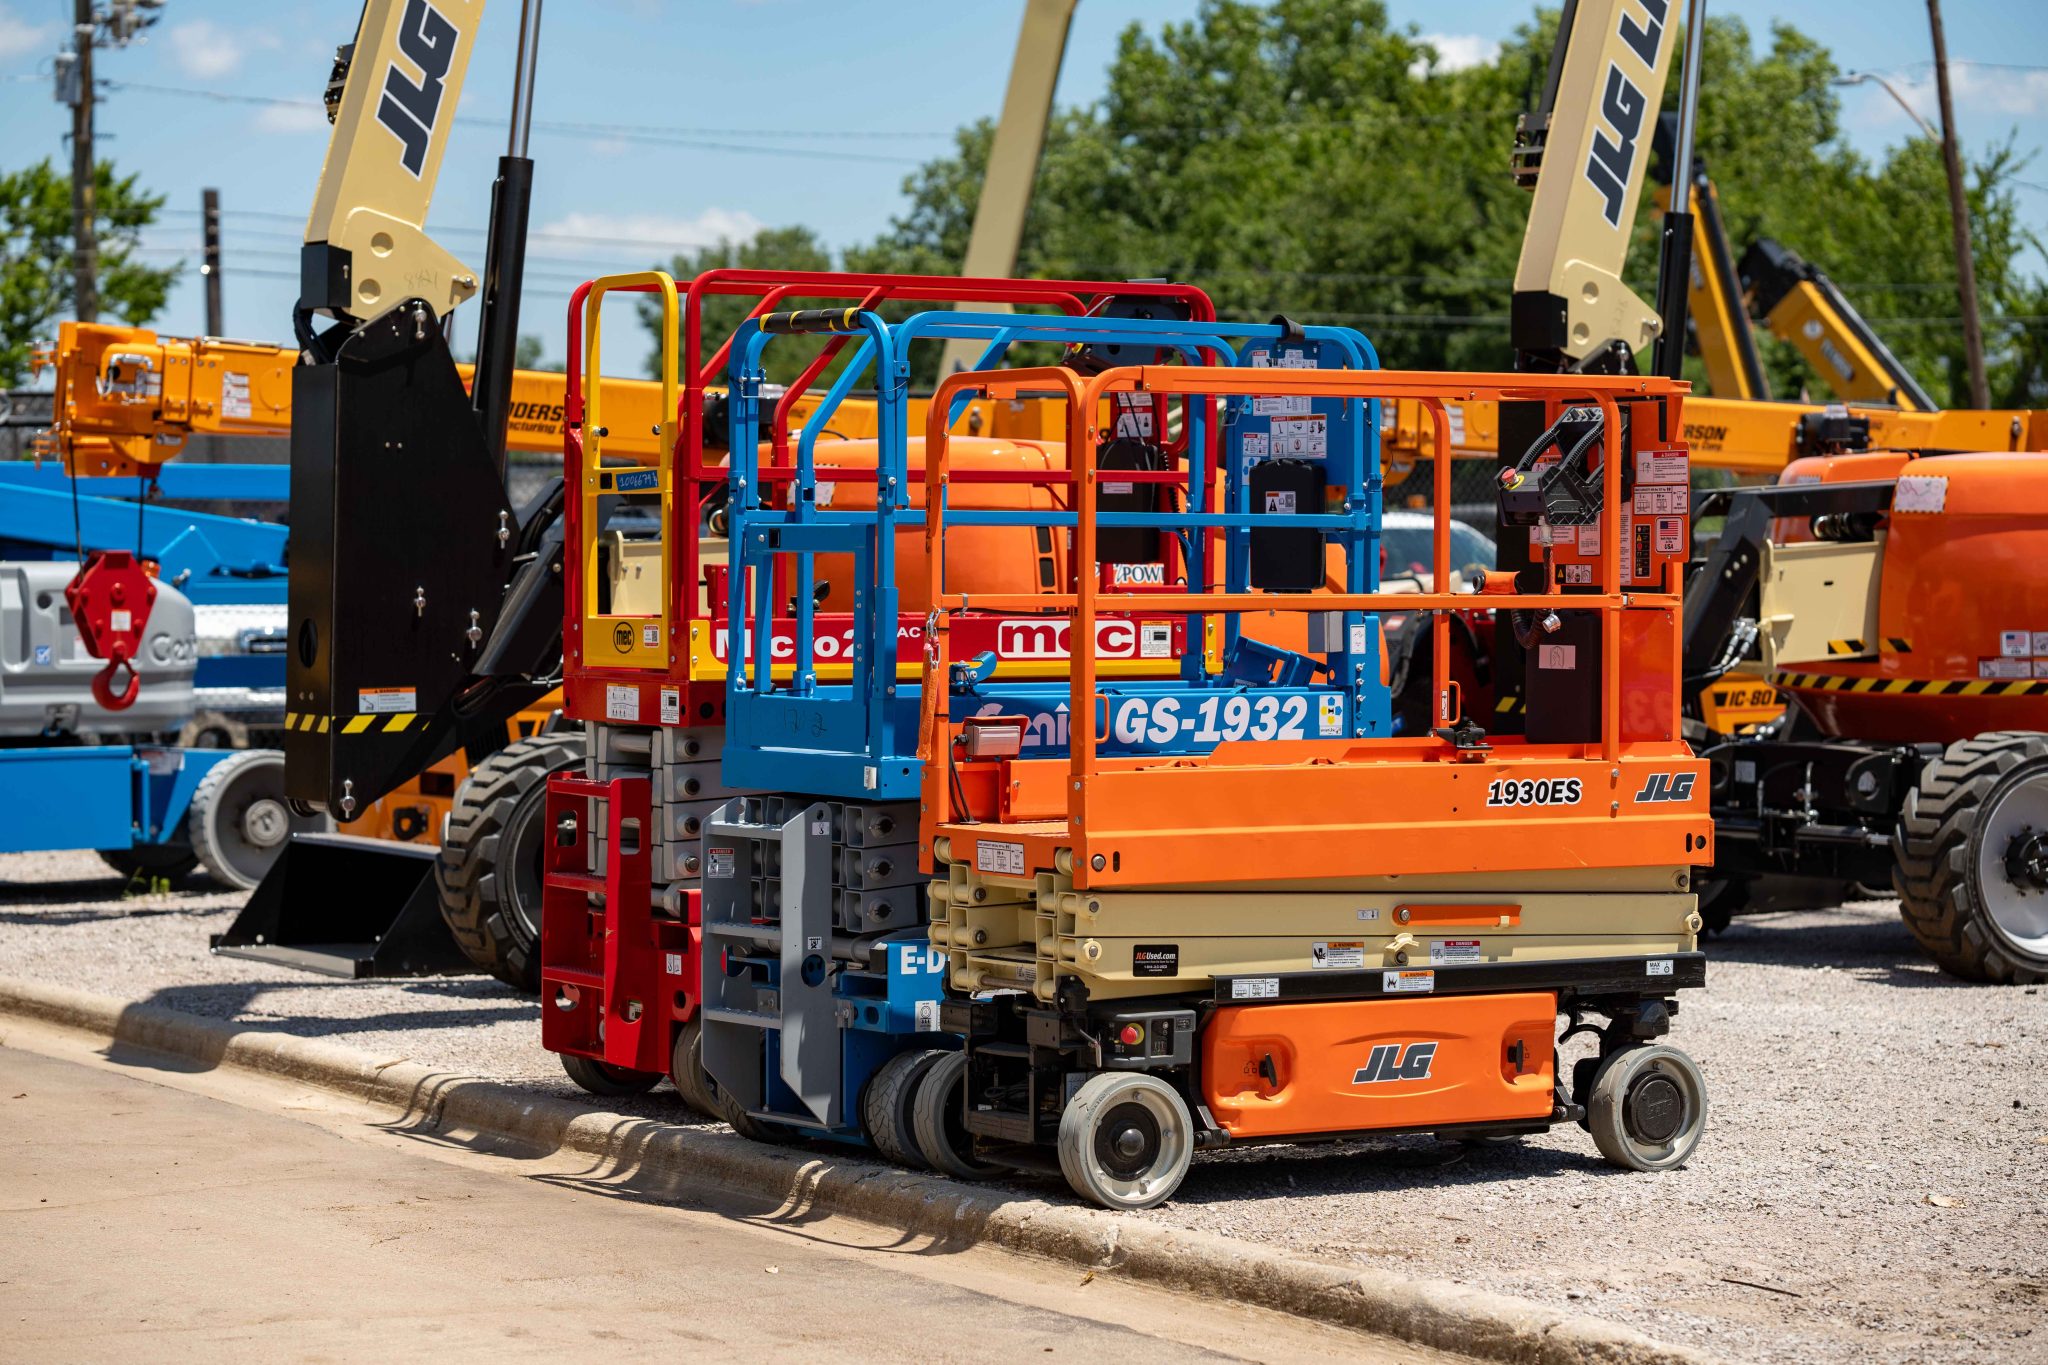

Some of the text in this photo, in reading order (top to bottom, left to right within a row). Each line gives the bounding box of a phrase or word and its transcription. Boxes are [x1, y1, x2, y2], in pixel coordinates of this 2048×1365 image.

[375, 0, 461, 182] JLG
[1585, 60, 1648, 231] JLG
[509, 402, 565, 422] DERS
[616, 629, 632, 646] mec
[1001, 625, 1133, 653] mc
[1115, 696, 1308, 744] GS-1932
[1487, 778, 1583, 806] 1930ES
[1634, 772, 1698, 803] JLG
[900, 945, 951, 975] E-D
[1352, 1042, 1439, 1085] JLG
